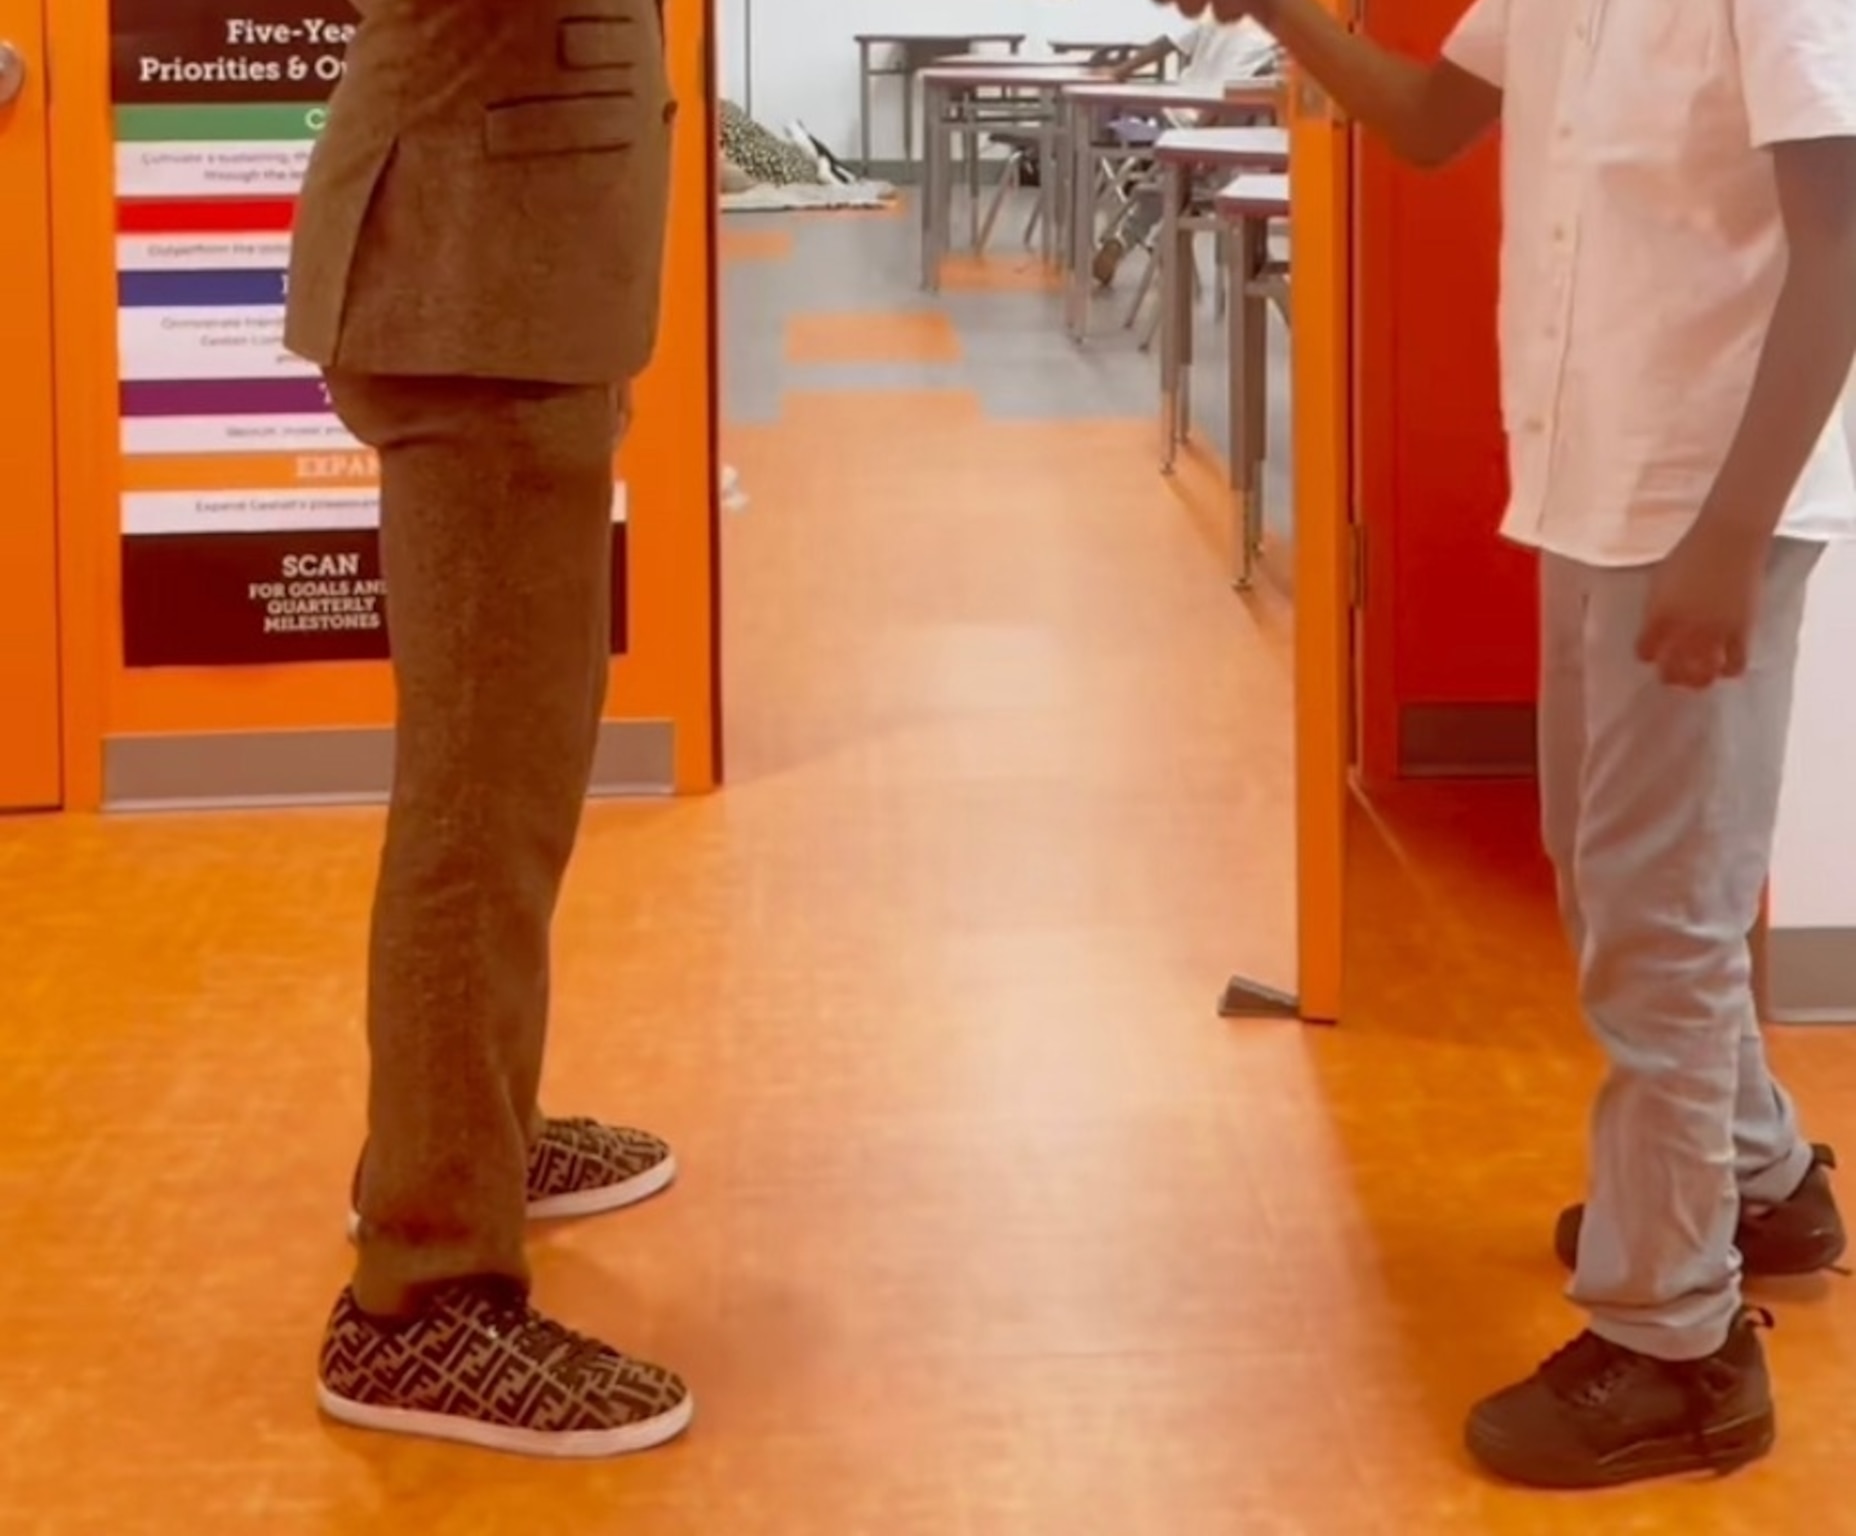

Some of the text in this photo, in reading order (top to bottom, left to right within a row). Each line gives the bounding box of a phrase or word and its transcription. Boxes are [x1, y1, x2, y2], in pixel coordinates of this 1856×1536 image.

[138, 56, 281, 82] Priorities
[287, 55, 308, 80] &
[281, 553, 359, 578] SCAN
[248, 582, 286, 600] FOR
[287, 580, 350, 598] GOALS
[266, 596, 377, 615] QUARTERLY
[263, 612, 381, 633] MILESTONES
